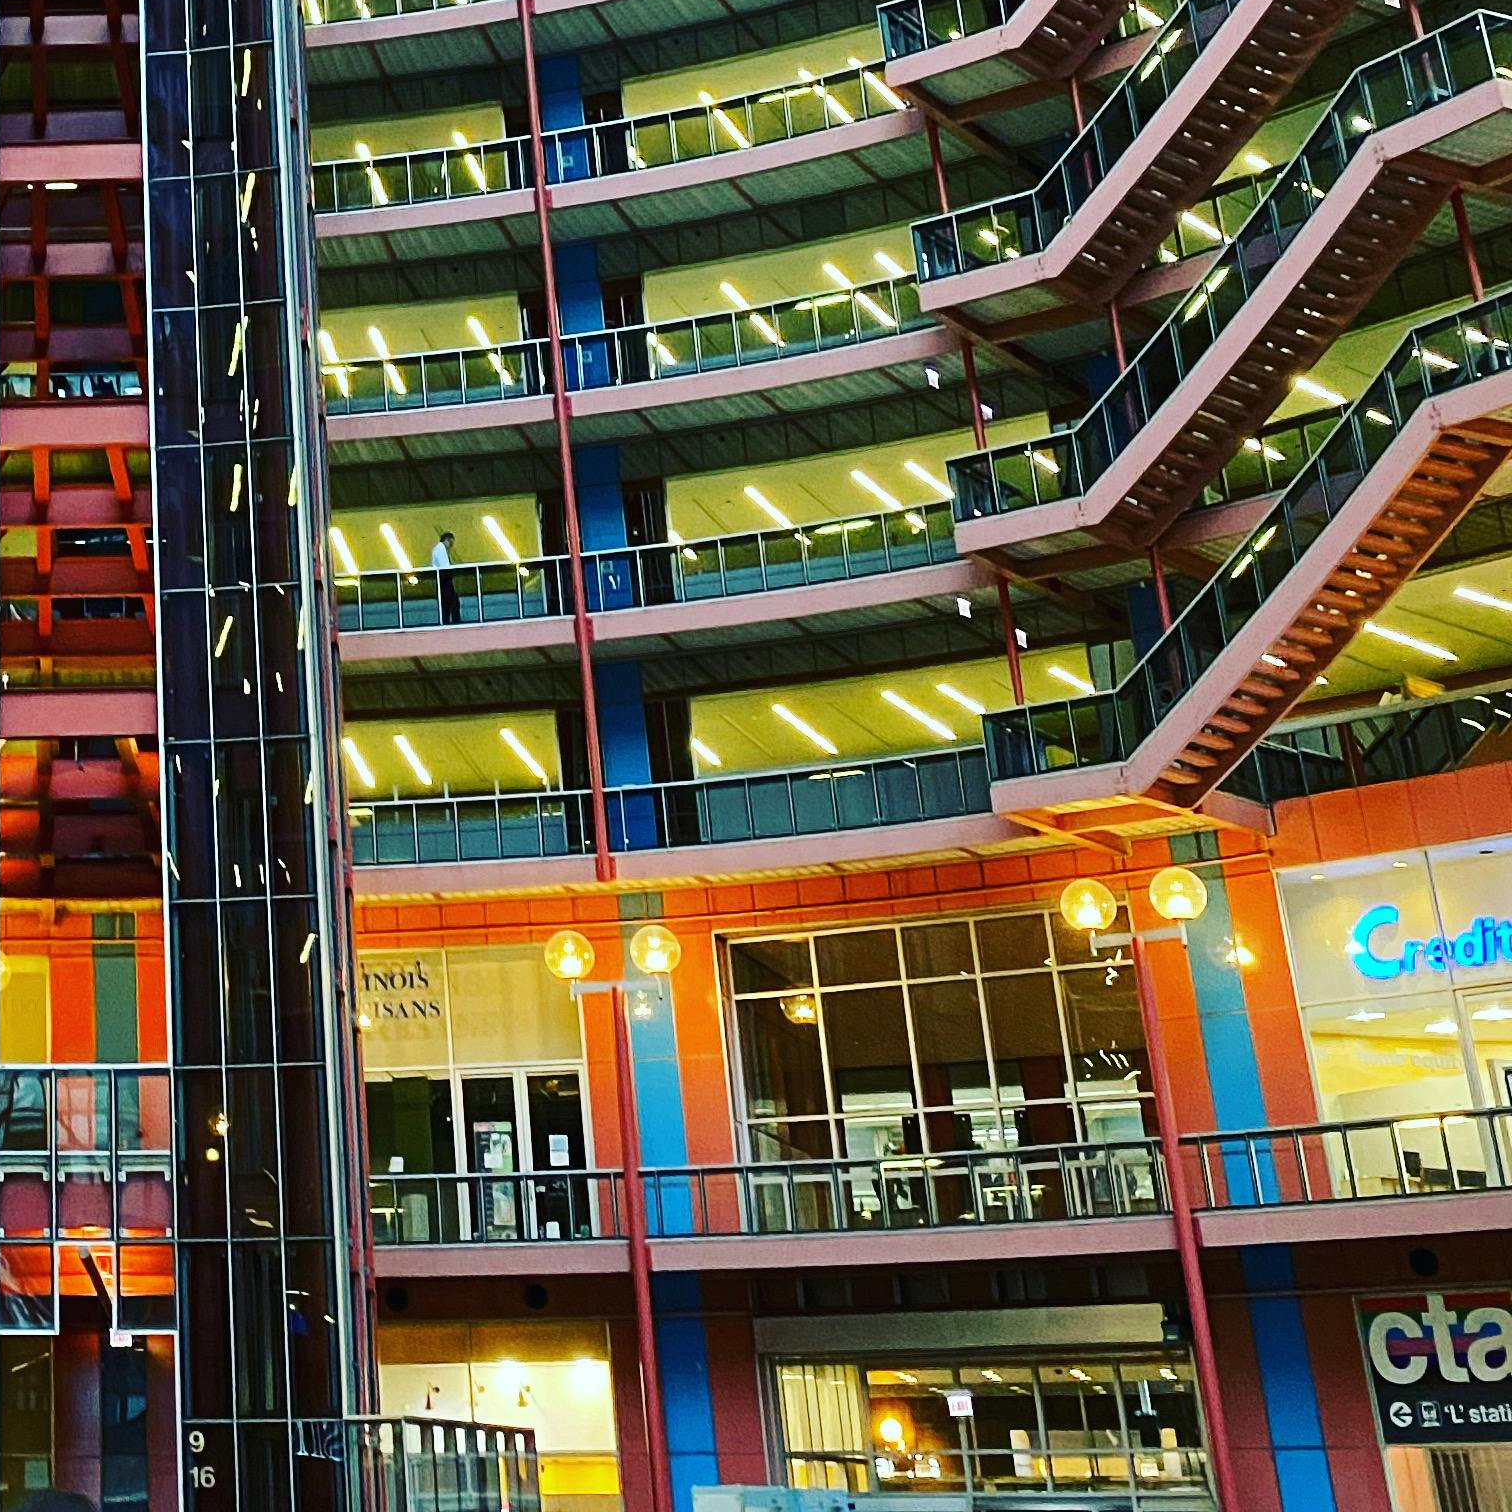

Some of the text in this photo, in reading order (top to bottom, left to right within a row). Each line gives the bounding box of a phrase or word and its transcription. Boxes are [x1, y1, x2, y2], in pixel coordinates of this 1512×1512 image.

[1352, 904, 1512, 979] Credit
[362, 972, 429, 991] INOIS
[372, 999, 441, 1020] ISANS
[1369, 1294, 1512, 1384] cta
[188, 1430, 205, 1453] 9
[190, 1466, 216, 1488] 16
